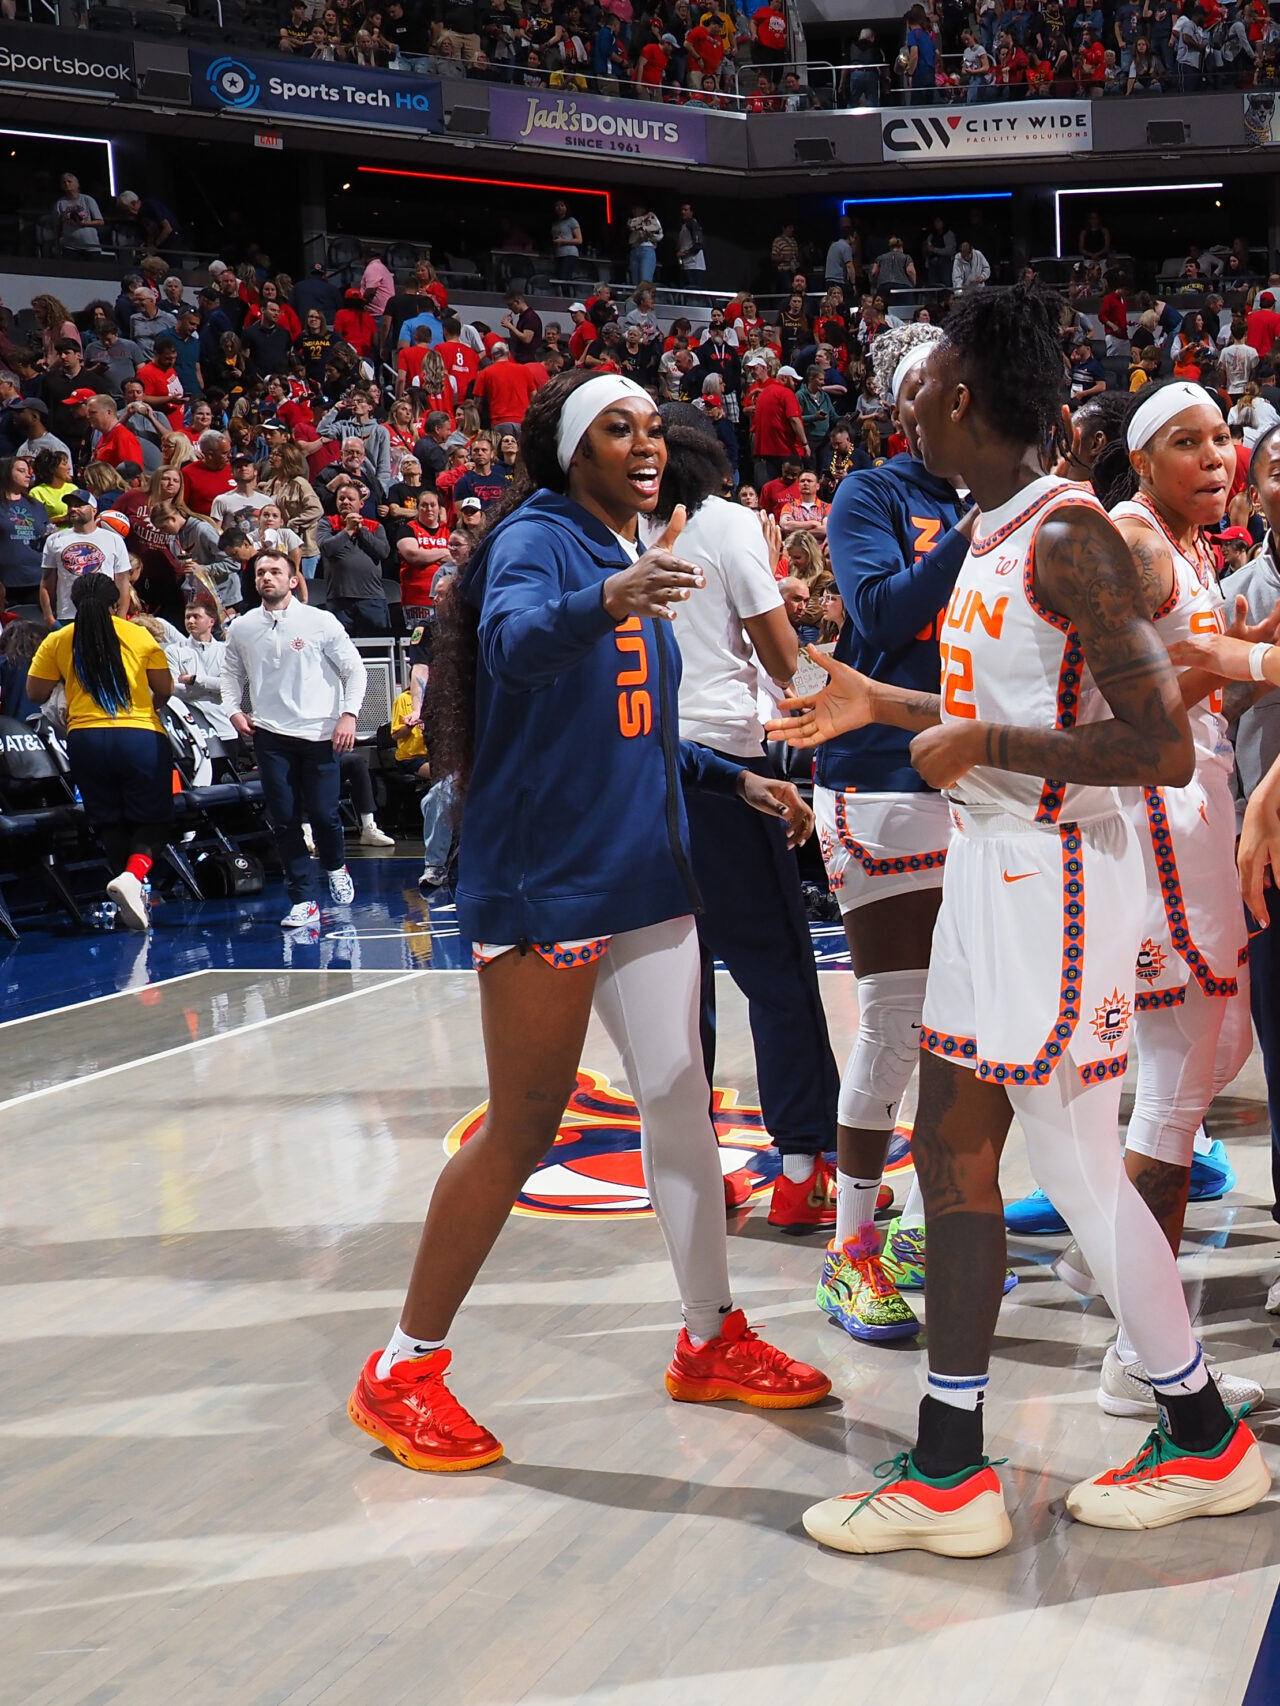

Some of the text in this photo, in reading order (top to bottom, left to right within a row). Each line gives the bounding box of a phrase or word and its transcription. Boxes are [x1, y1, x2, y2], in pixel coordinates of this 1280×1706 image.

[0, 46, 131, 81] Sportsbook
[269, 77, 430, 112] Sports Tech HQ
[520, 97, 679, 143] Jack's DONUTS
[966, 114, 1088, 133] CITY WIDE
[1025, 131, 1088, 140] SOLUTIONS
[565, 136, 641, 153] SINCE 1961
[310, 346, 322, 357] 22
[456, 352, 464, 366] 8
[418, 537, 447, 546] FEVER
